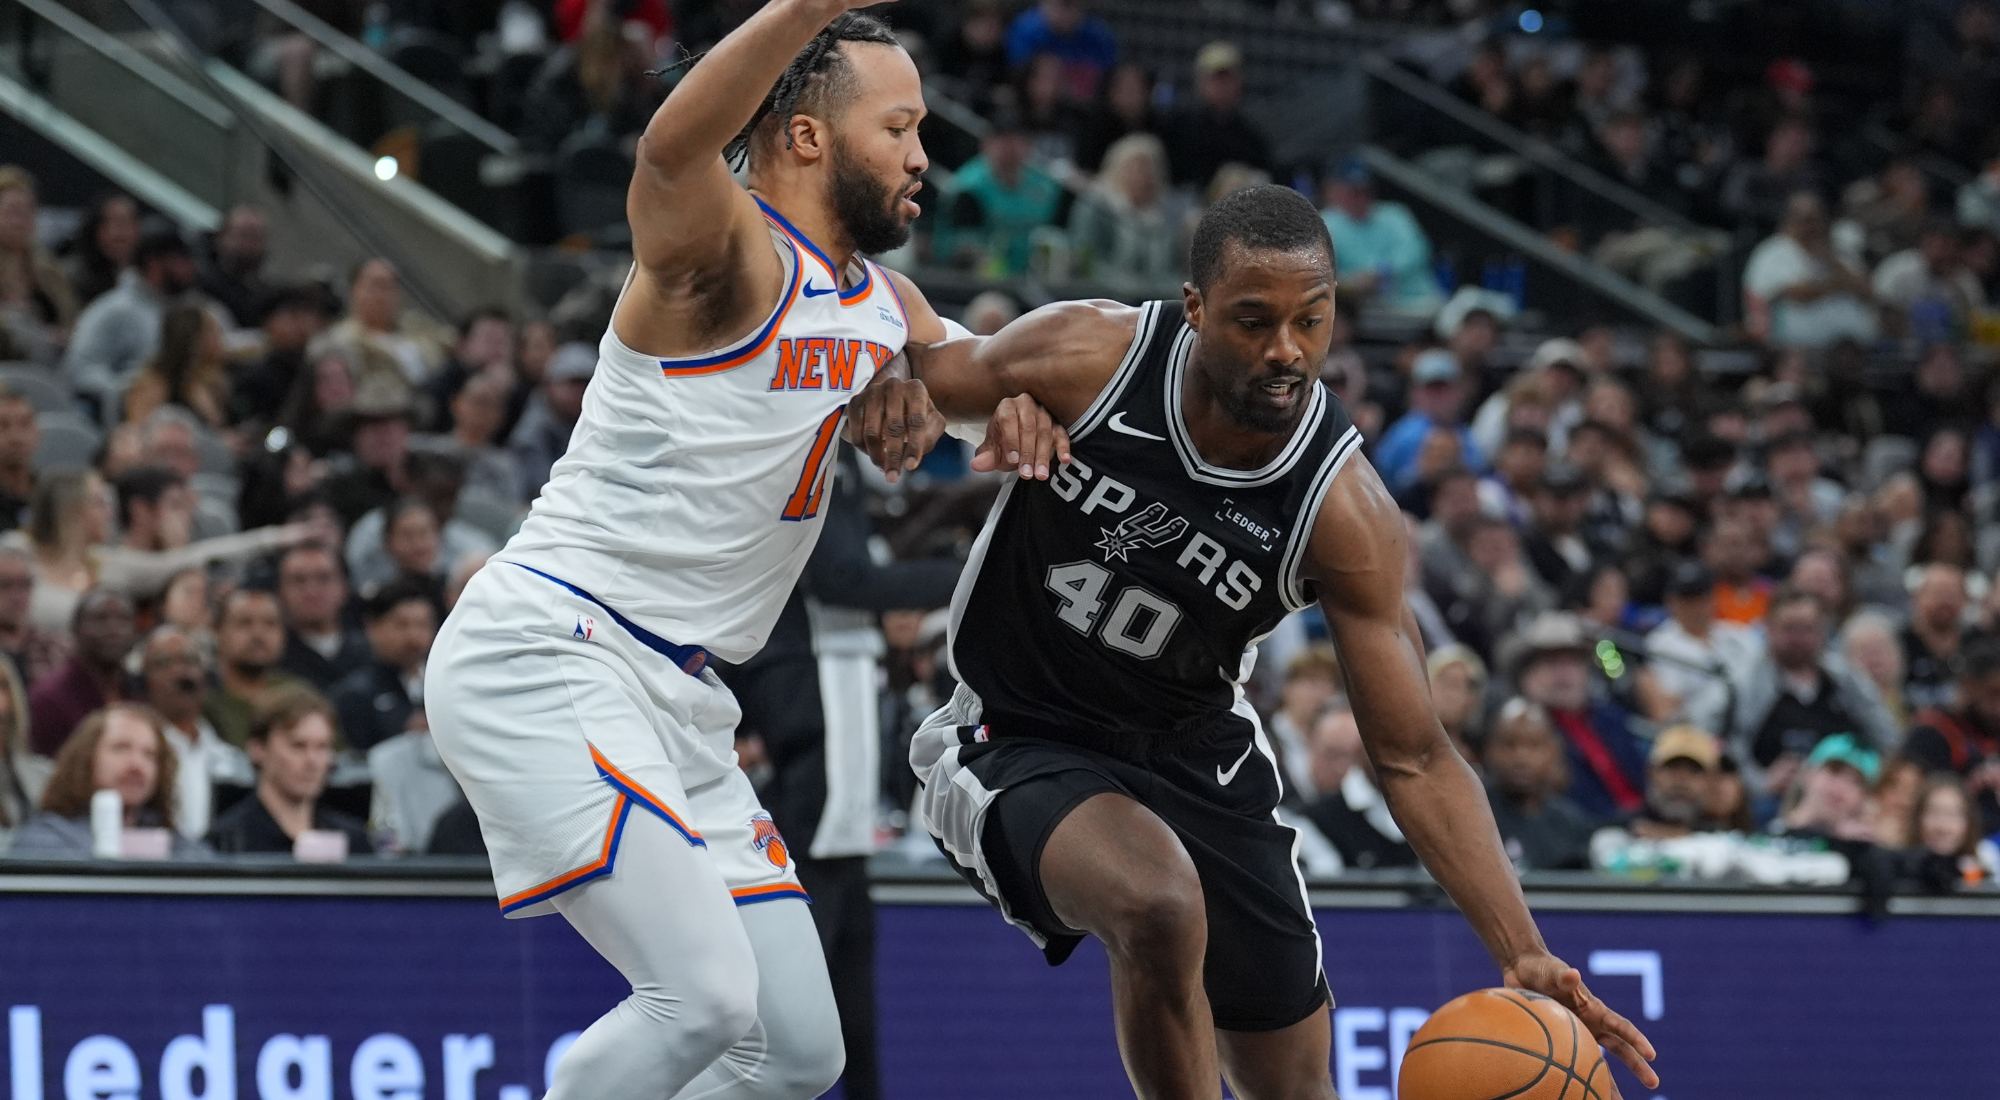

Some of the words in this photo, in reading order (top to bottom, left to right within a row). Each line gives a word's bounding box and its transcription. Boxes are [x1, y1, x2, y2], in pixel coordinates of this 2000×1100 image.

[767, 337, 863, 392] NEW
[1225, 507, 1270, 541] LEDGER
[1044, 559, 1184, 661] 40
